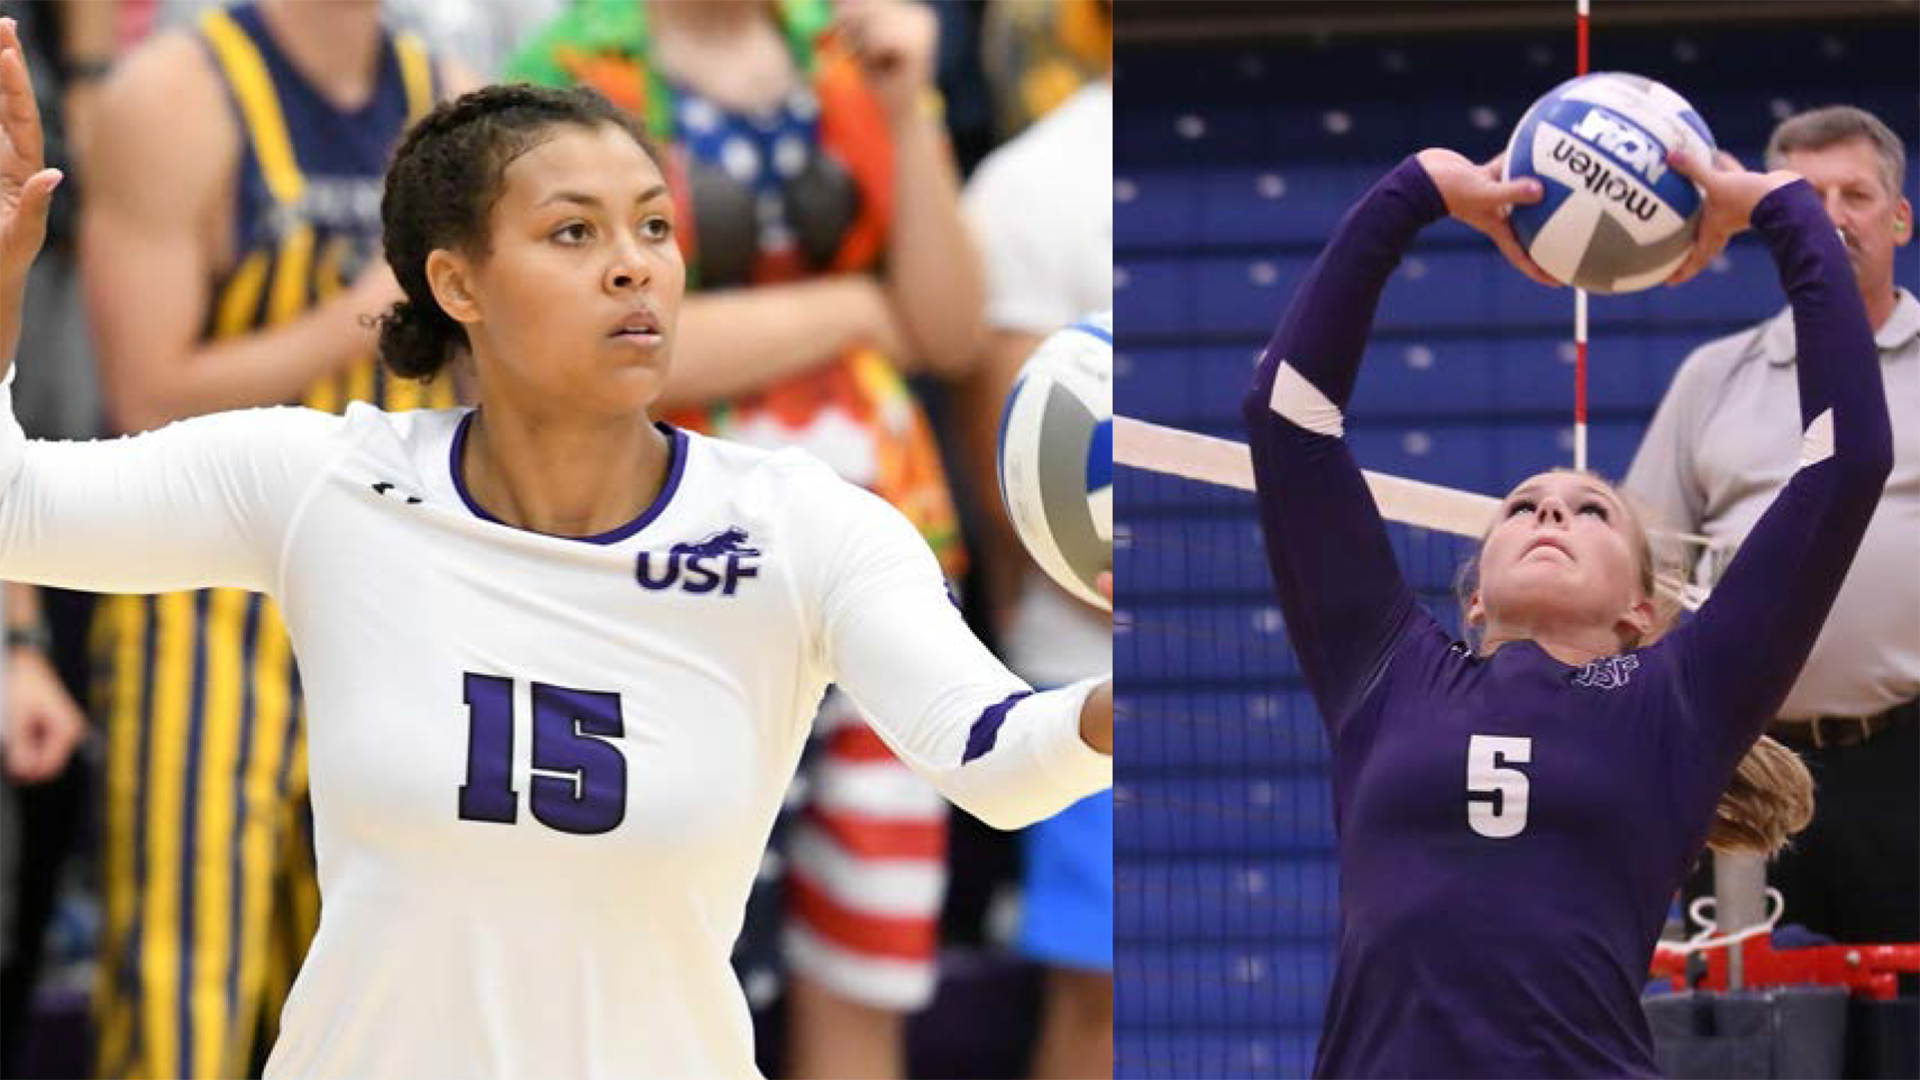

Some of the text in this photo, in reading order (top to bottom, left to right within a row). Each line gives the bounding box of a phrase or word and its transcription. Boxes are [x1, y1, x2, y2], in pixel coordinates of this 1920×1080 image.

[1553, 138, 1658, 221] molten
[636, 543, 759, 595] USF
[458, 671, 628, 835] 15
[1467, 734, 1532, 838] 5
